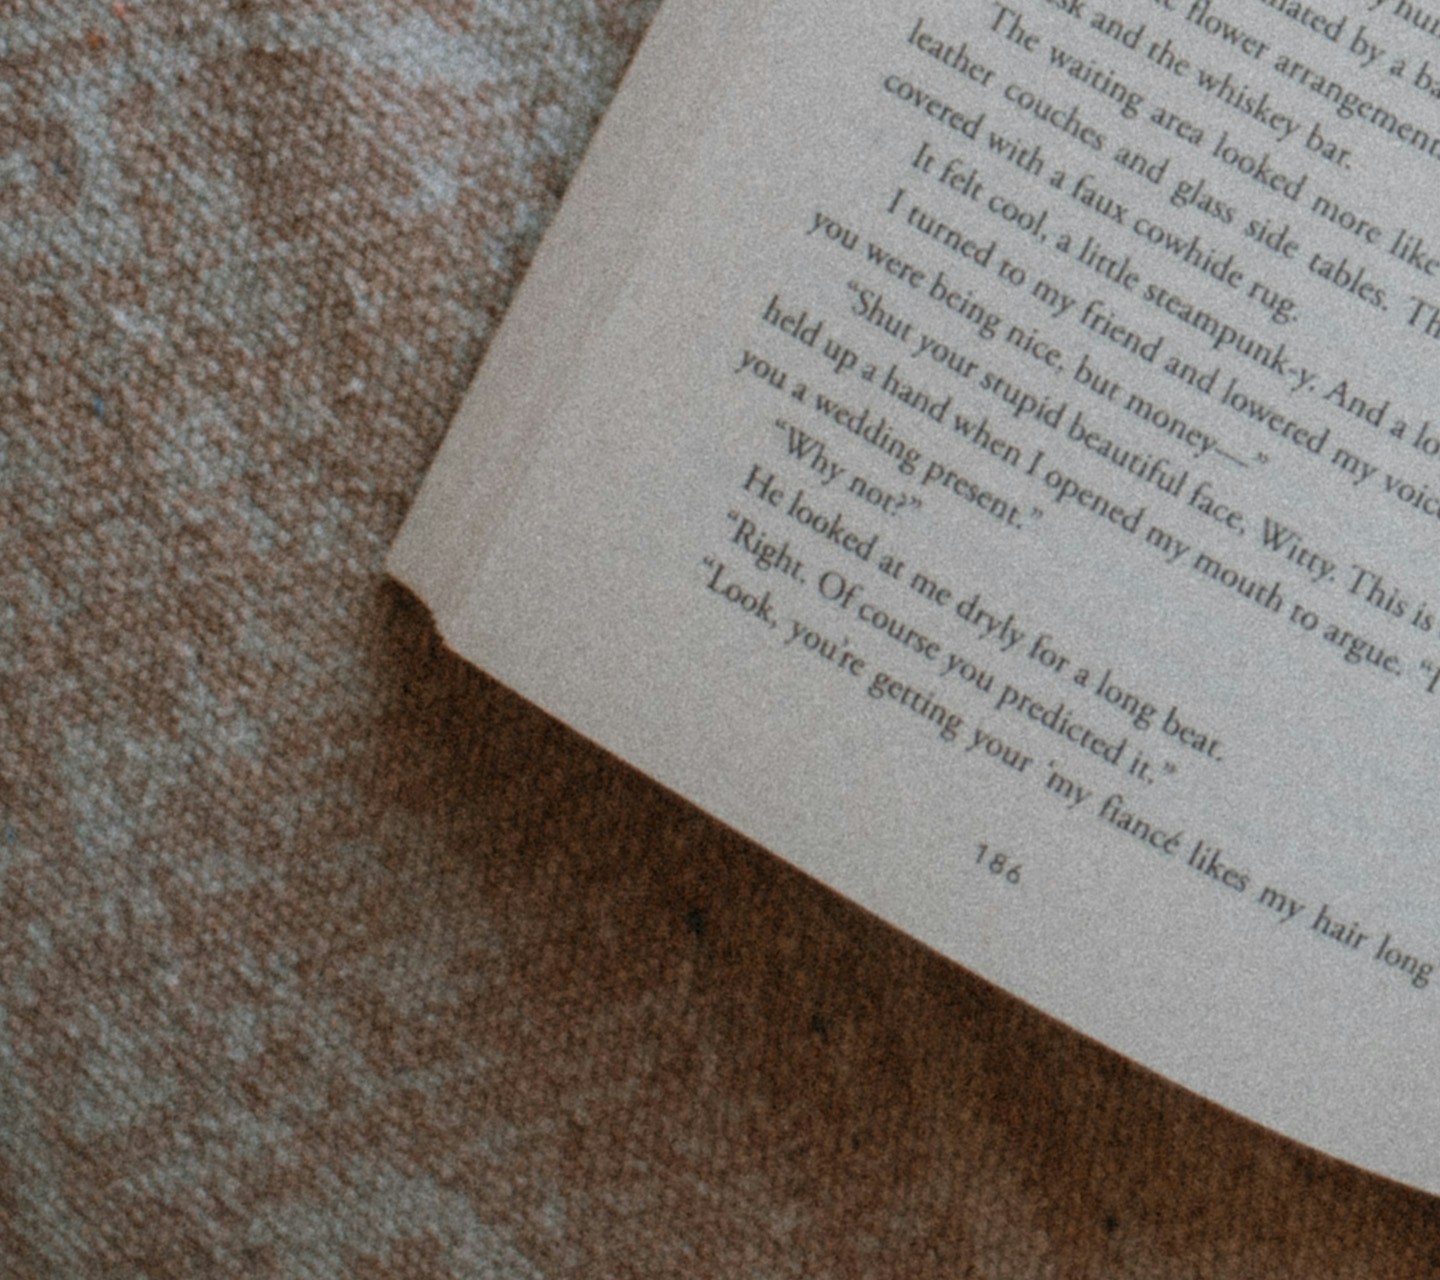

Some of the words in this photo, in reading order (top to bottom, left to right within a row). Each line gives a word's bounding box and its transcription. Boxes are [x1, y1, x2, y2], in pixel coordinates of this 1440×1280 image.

[700, 555, 778, 629] “Look,
[783, 618, 866, 678] you’re
[864, 670, 964, 743] getting
[964, 726, 1034, 774] your
[1096, 792, 1183, 856] fiancé
[1185, 838, 1251, 894] likes
[1255, 884, 1306, 924] my
[1308, 901, 1369, 951] hair
[973, 840, 1023, 887] 186
